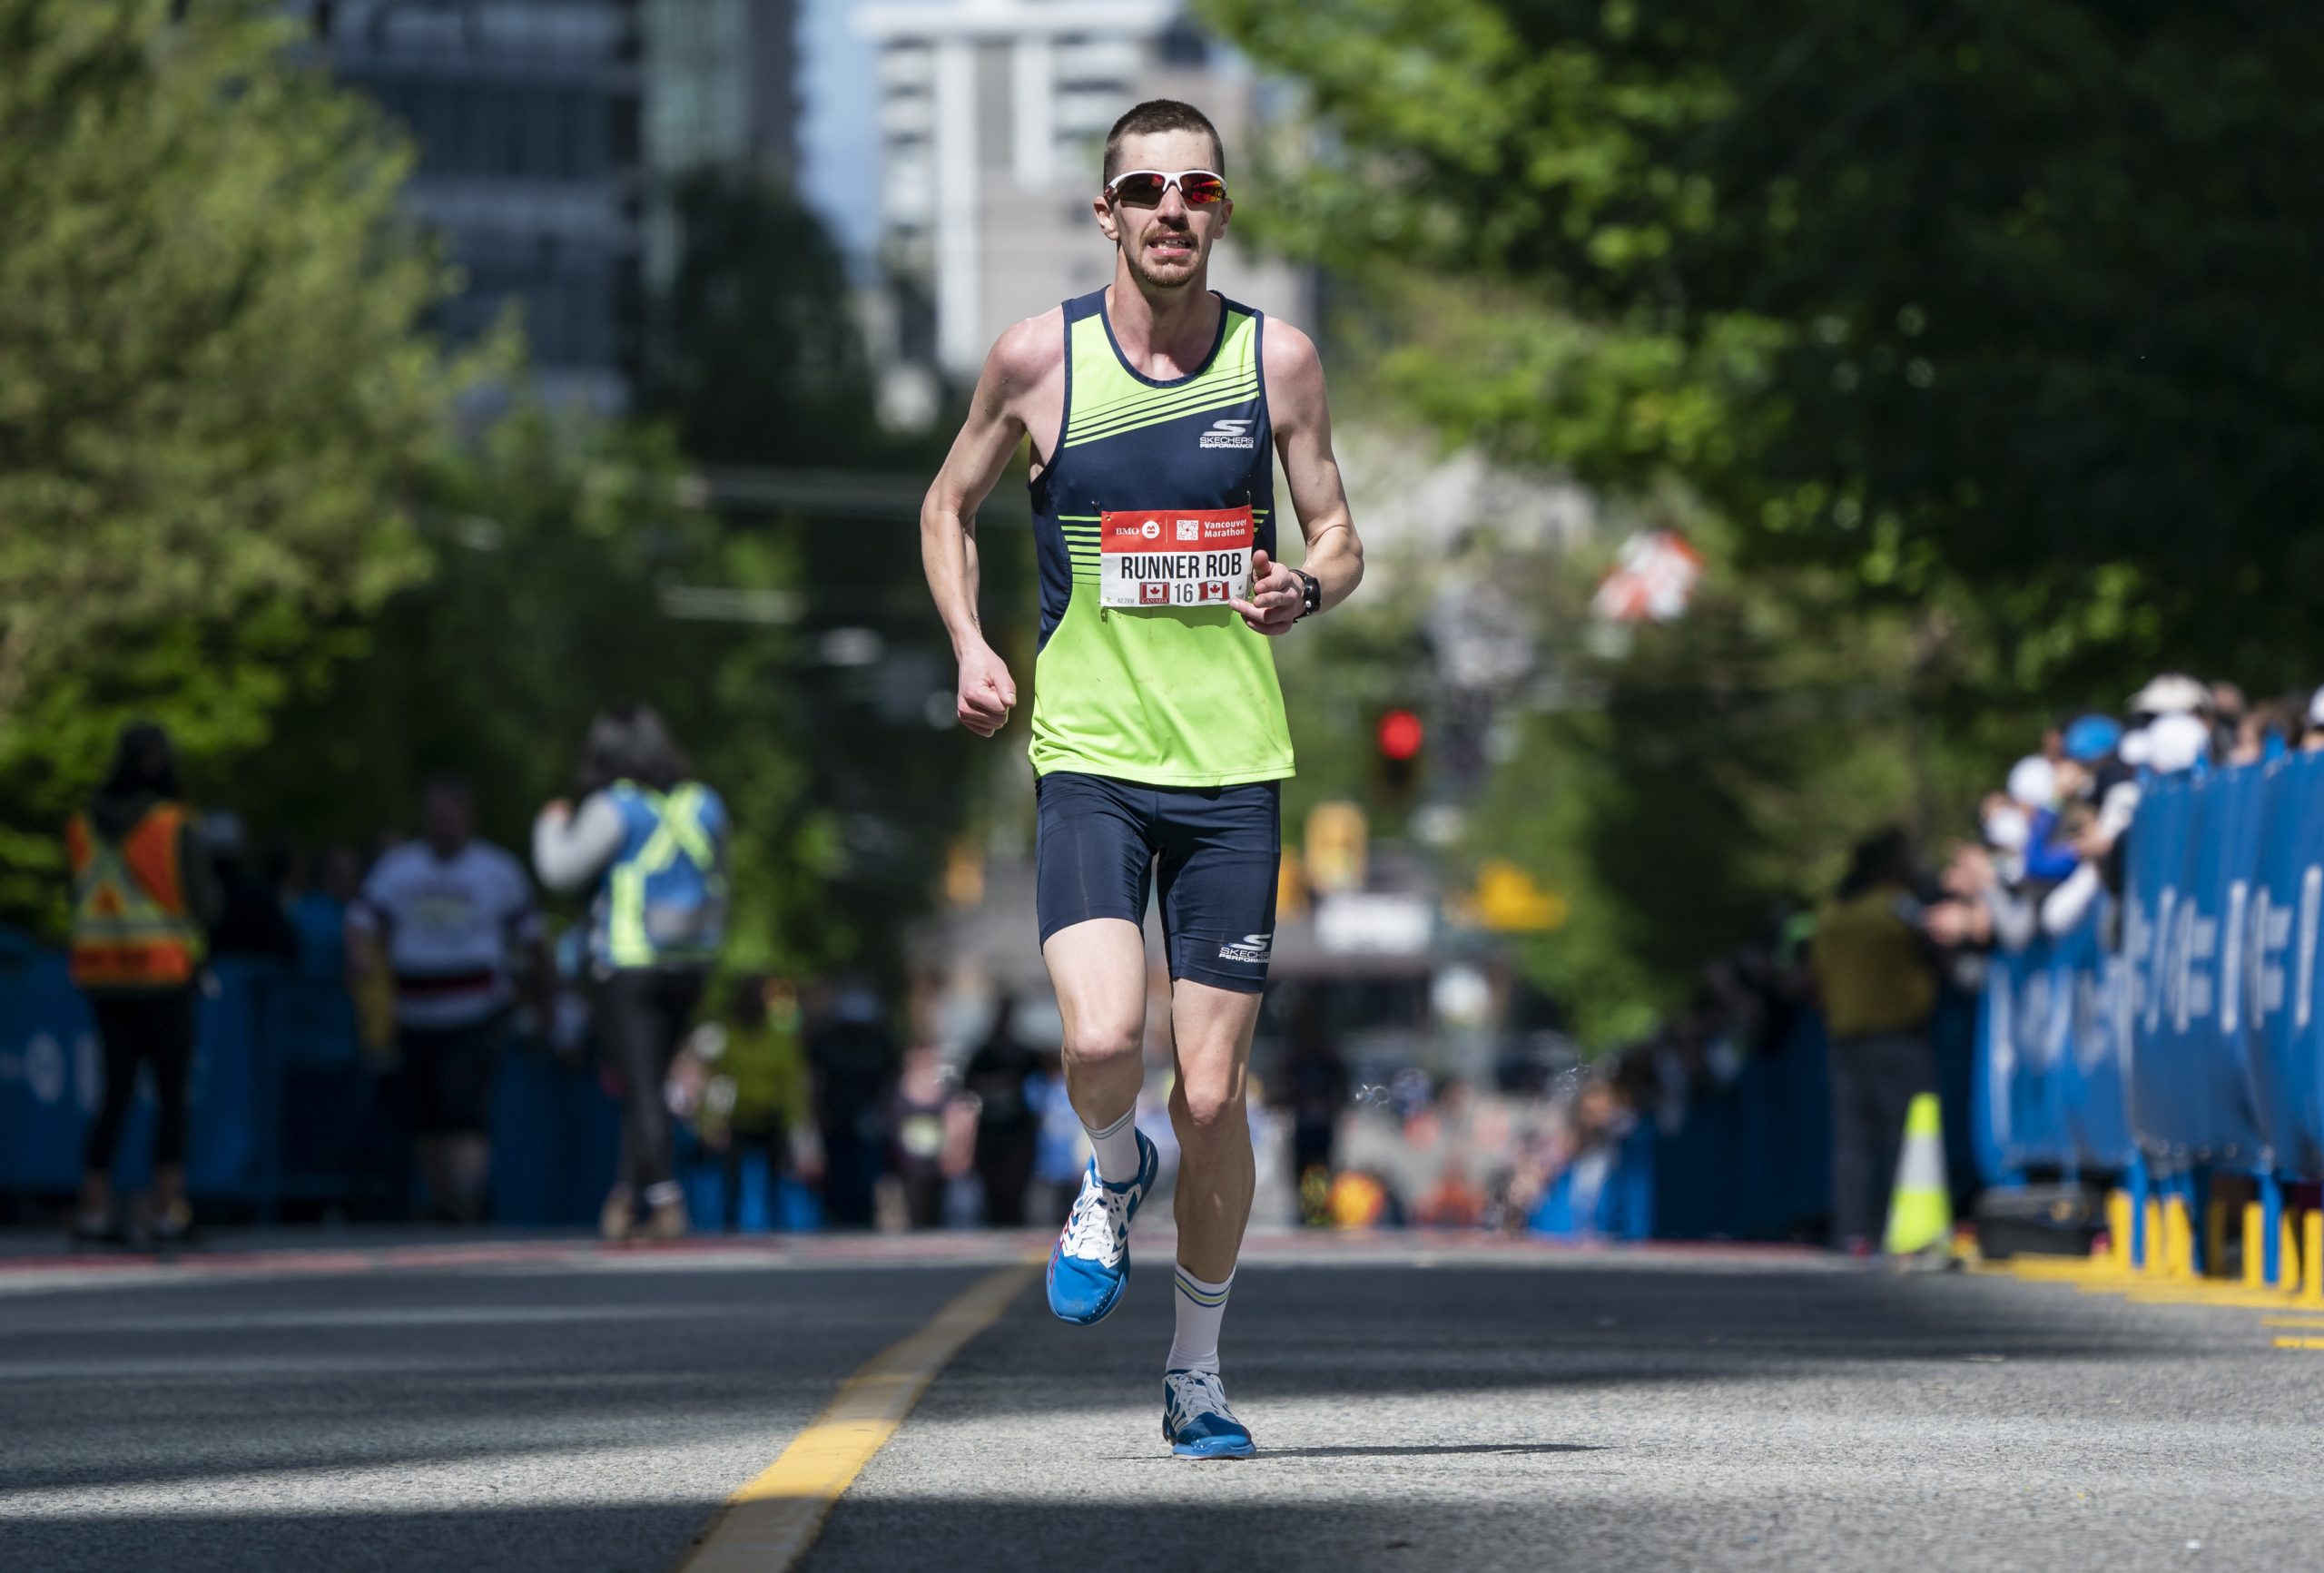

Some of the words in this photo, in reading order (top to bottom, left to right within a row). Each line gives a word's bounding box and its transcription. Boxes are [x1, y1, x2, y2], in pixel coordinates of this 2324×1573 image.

[1204, 518, 1246, 530] Vancouver
[1116, 527, 1139, 536] BMO
[1204, 527, 1246, 538] Marathon
[1121, 555, 1200, 579] RUNNER
[1206, 552, 1242, 577] ROB
[1174, 583, 1194, 604] 16
